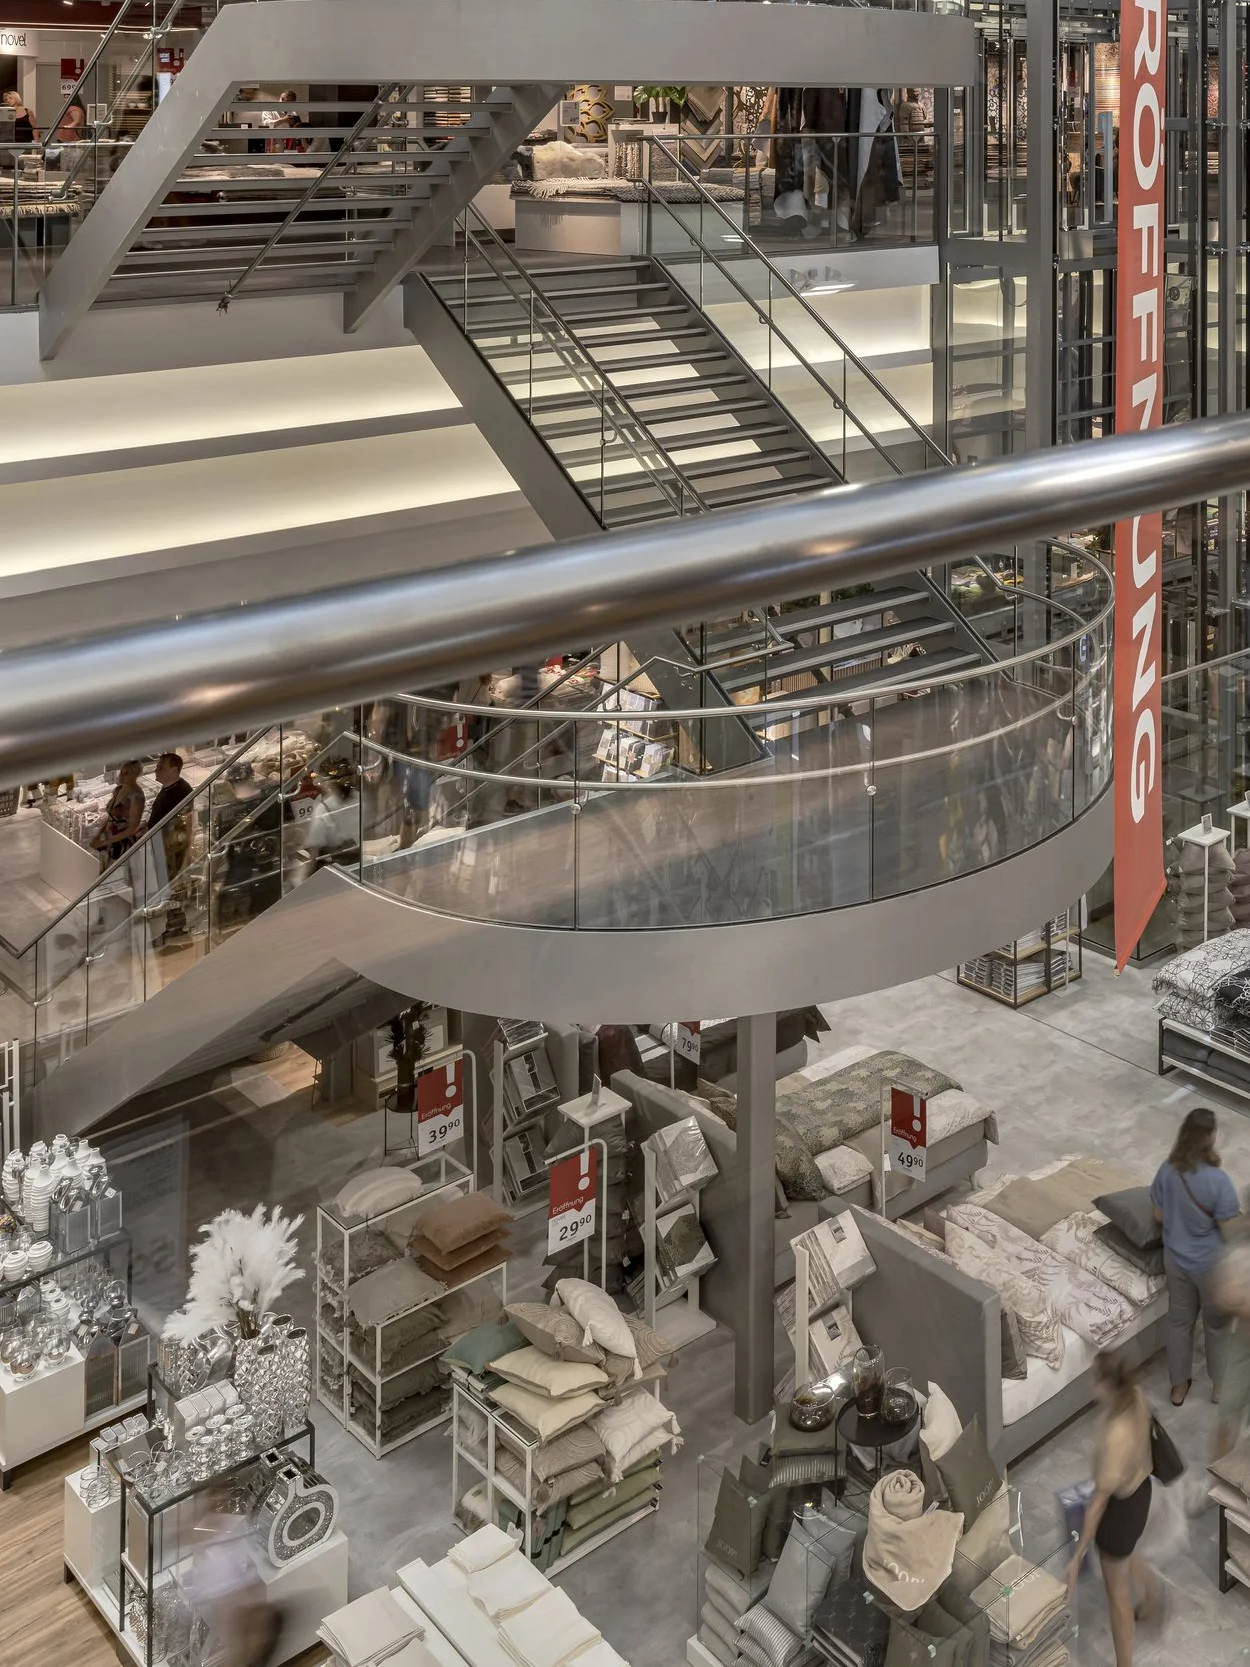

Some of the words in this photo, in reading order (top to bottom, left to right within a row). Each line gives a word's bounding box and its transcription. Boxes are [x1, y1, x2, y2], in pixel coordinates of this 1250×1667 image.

[0, 33, 27, 47] novel
[421, 1102, 452, 1120] Eröffnung
[893, 1126, 918, 1143] Eröffnung
[552, 1196, 584, 1215] Eröffnung
